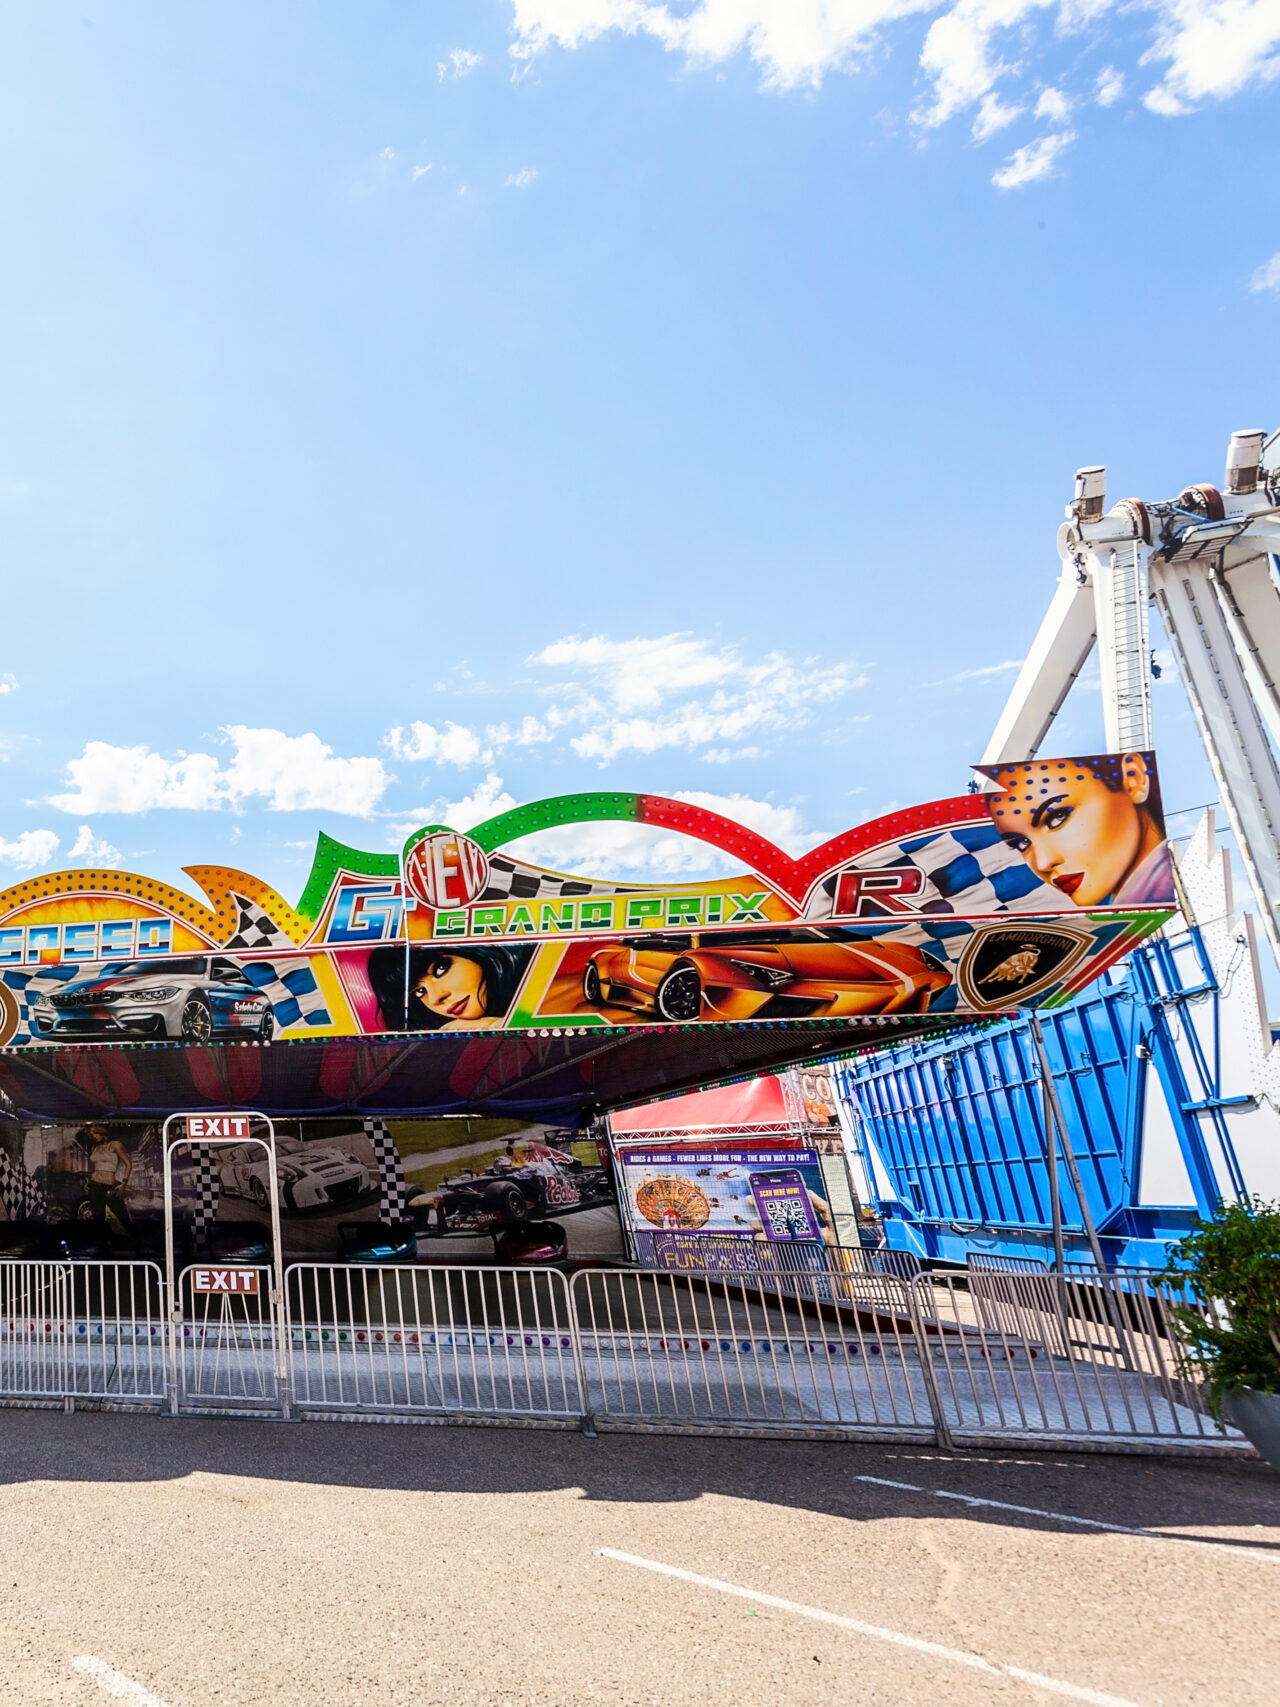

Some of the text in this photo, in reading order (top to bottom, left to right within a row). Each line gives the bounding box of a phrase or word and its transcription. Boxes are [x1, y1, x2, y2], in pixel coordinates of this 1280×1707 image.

[409, 833, 487, 908] NEW
[831, 866, 925, 920] R
[326, 882, 418, 943] GT
[433, 891, 773, 938] GRAND PRIX
[989, 931, 1074, 952] LAMBORGHINI
[252, 1002, 264, 1012] Car
[189, 1118, 247, 1137] EXIT
[630, 1155, 646, 1163] RIDES
[652, 1155, 672, 1163] GAMES
[676, 1154, 696, 1162] FEWER
[696, 1154, 712, 1162] LINES
[713, 1154, 730, 1162] MORE
[730, 1154, 742, 1162] FUN
[747, 1154, 758, 1162] THE
[773, 1154, 786, 1162] WAY
[795, 1153, 810, 1161] PAY!
[477, 1213, 497, 1223] TOTAL
[194, 1270, 255, 1290] EXIT
